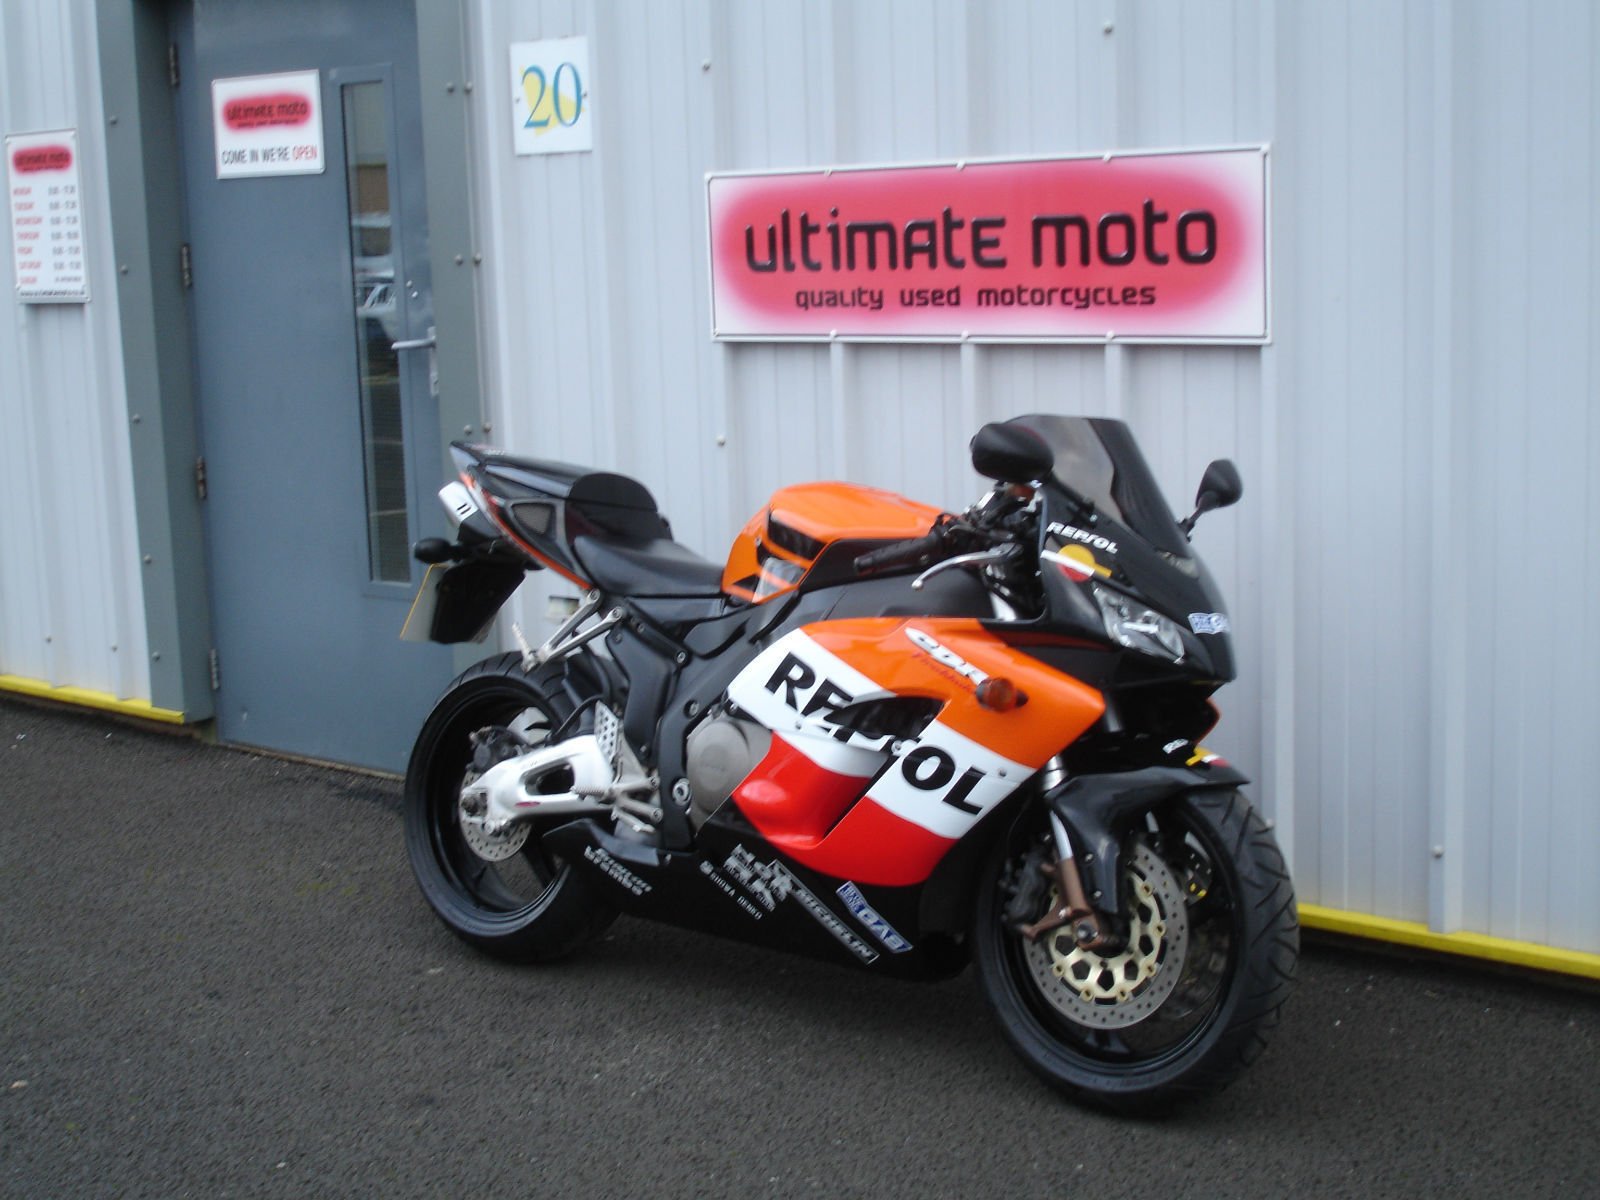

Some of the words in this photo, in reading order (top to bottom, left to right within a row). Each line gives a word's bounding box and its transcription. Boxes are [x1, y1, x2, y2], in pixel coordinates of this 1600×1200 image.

[522, 63, 584, 129] 20
[221, 149, 247, 165] COME
[250, 148, 259, 163] IN
[262, 146, 290, 163] WE'RE
[292, 145, 317, 161] OPEN
[1032, 198, 1218, 268] moto
[795, 286, 885, 312] quality
[899, 284, 962, 308] used
[977, 284, 1157, 310] motorcycles
[1046, 521, 1119, 554] REPSOL
[764, 652, 986, 815] REOL
